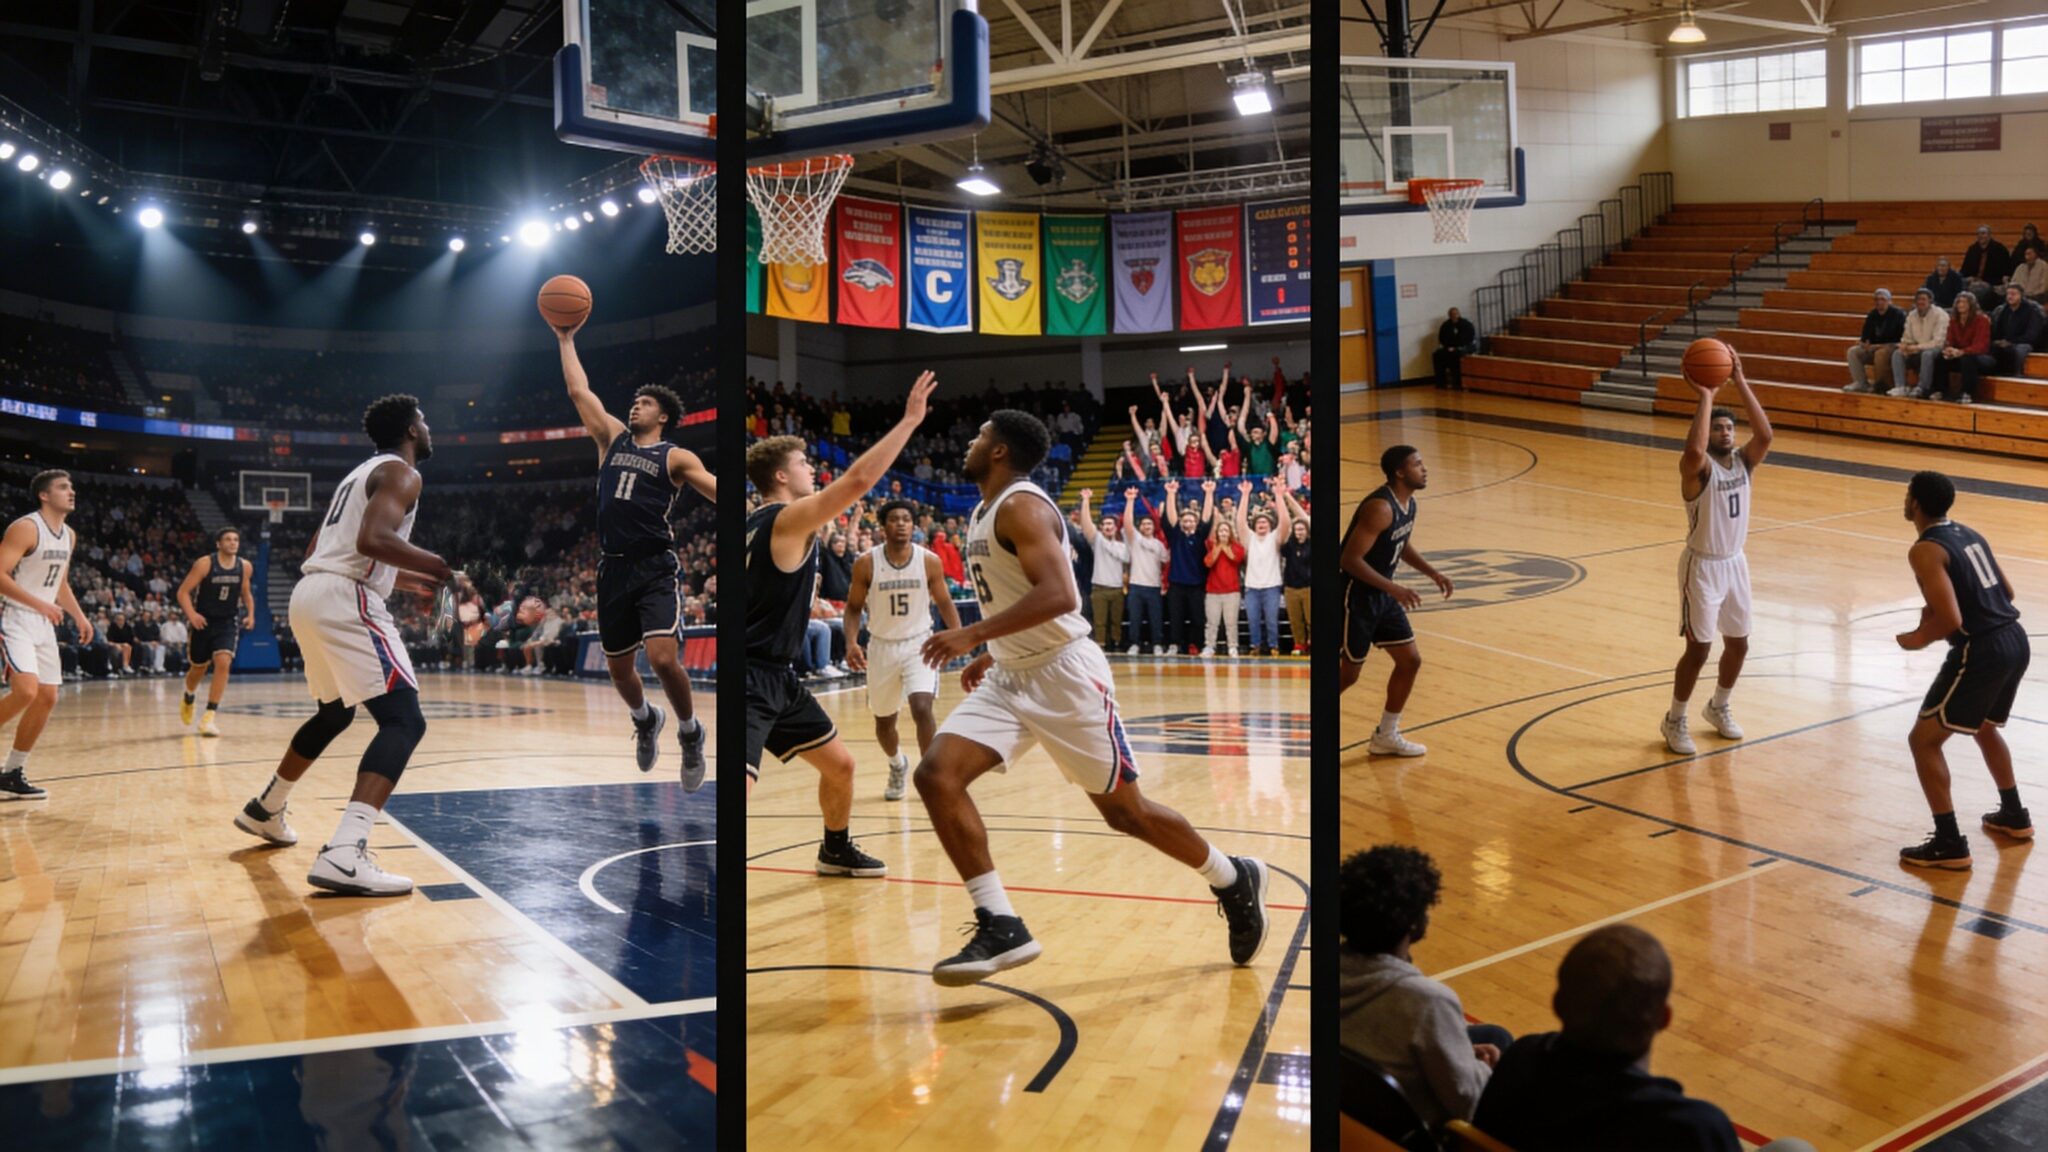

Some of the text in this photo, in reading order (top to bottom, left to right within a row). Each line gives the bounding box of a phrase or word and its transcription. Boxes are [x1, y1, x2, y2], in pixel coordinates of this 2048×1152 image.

[926, 269, 953, 304] C
[614, 471, 637, 500] 11
[1728, 493, 1740, 518] 0
[889, 593, 909, 616] 15
